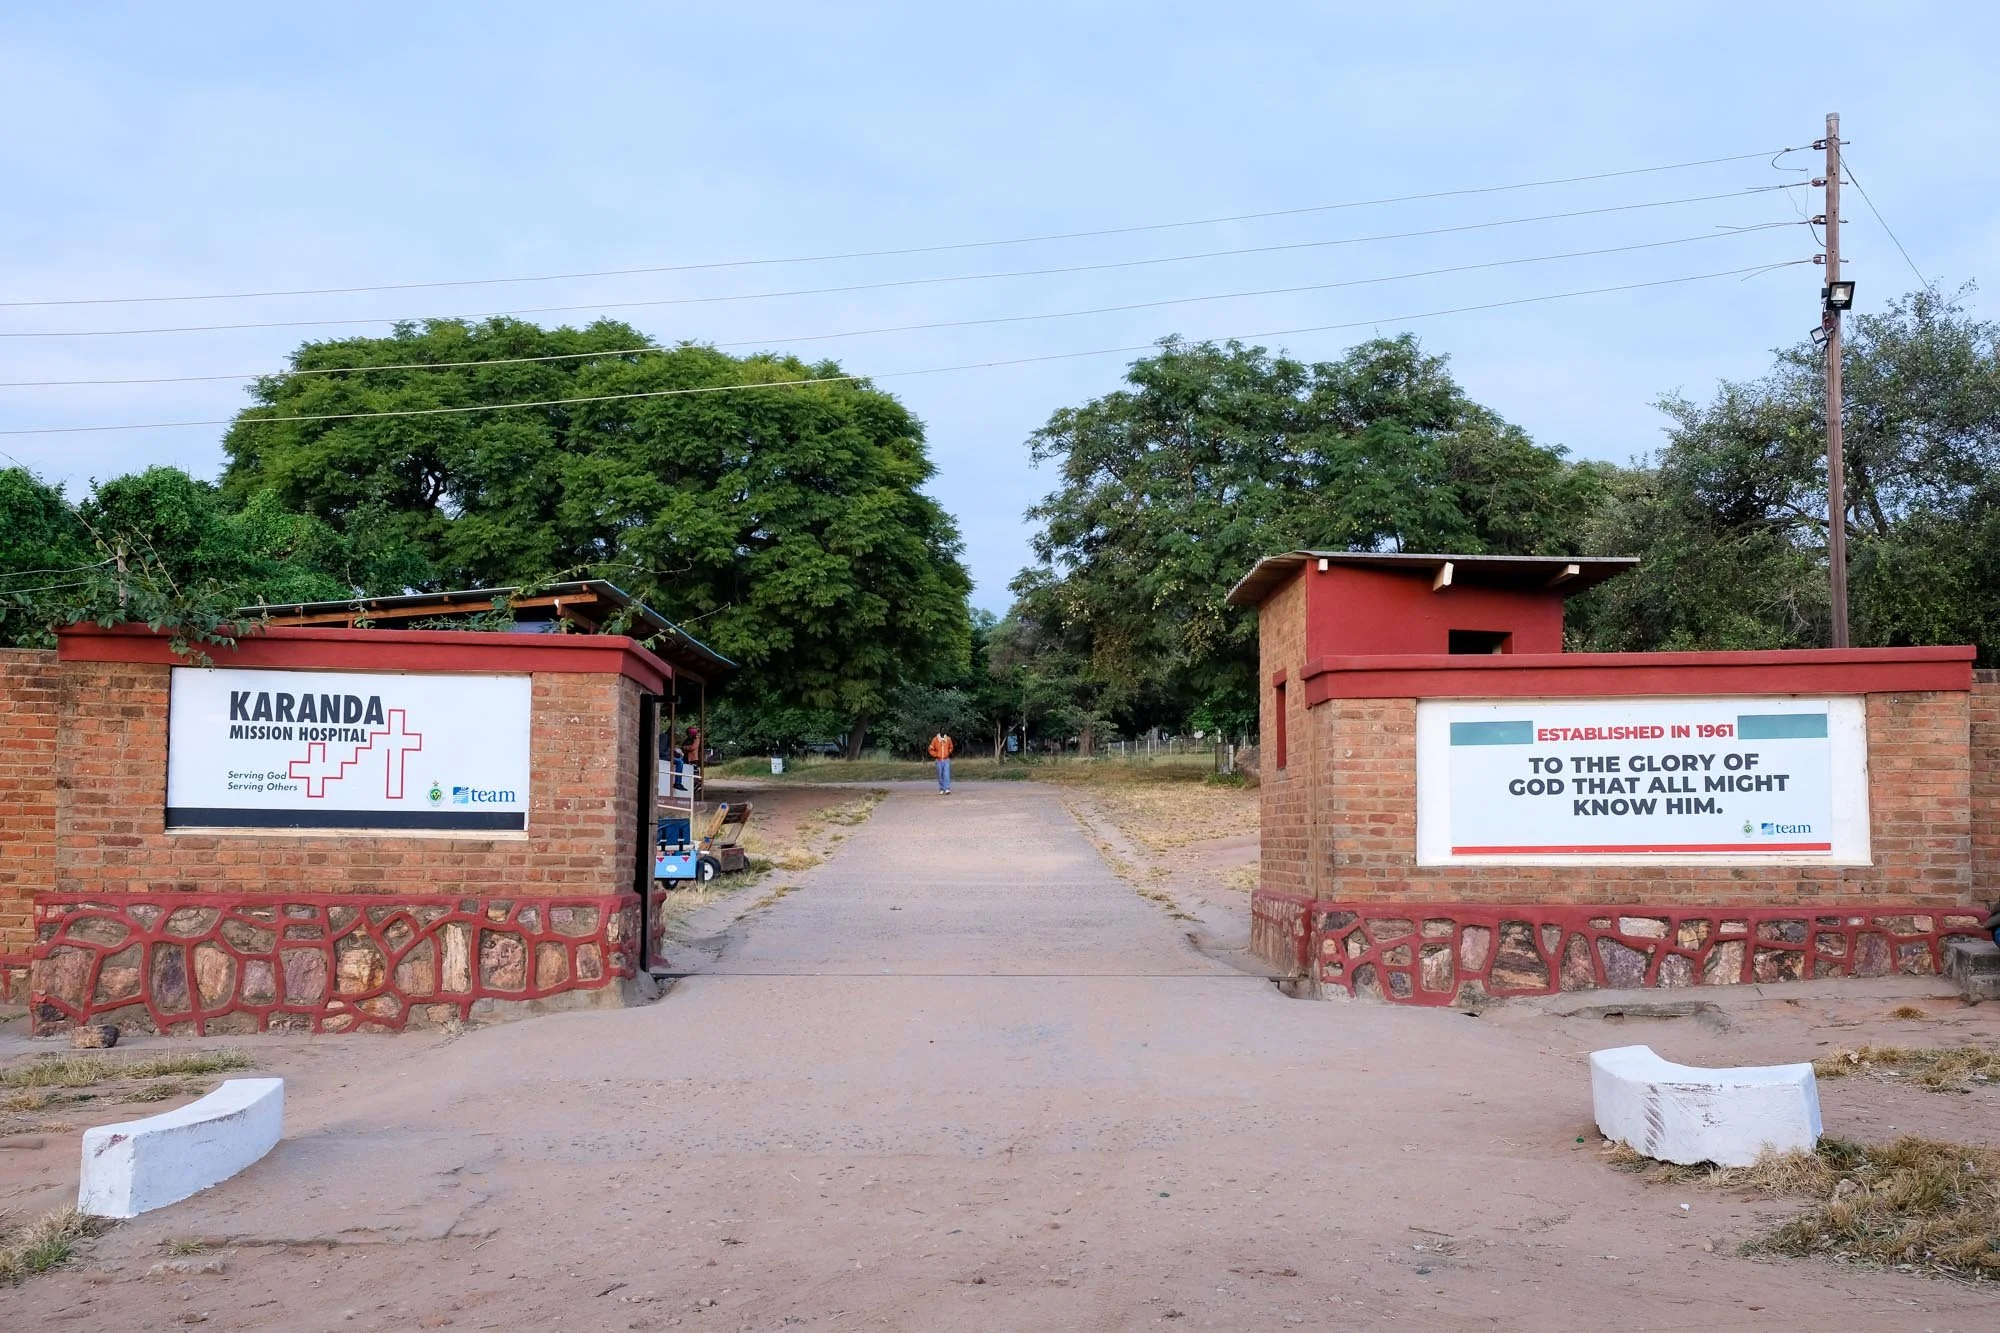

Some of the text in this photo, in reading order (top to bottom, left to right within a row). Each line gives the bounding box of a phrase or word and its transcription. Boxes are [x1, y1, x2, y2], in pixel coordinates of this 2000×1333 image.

[229, 690, 384, 725] KARANDA
[229, 724, 367, 743] MISSION HOSPITAL
[1537, 724, 1734, 741] ESTABLISHED IN 1961
[1528, 753, 1759, 774] TO THE GLORY OF
[227, 770, 287, 782] Serving God
[1508, 774, 1789, 796] GOD THAT ALL MIGHT
[227, 781, 298, 793] Serving Others
[470, 788, 516, 803] team
[1573, 797, 1723, 816] KNOW HIM.
[1775, 823, 1812, 834] team
